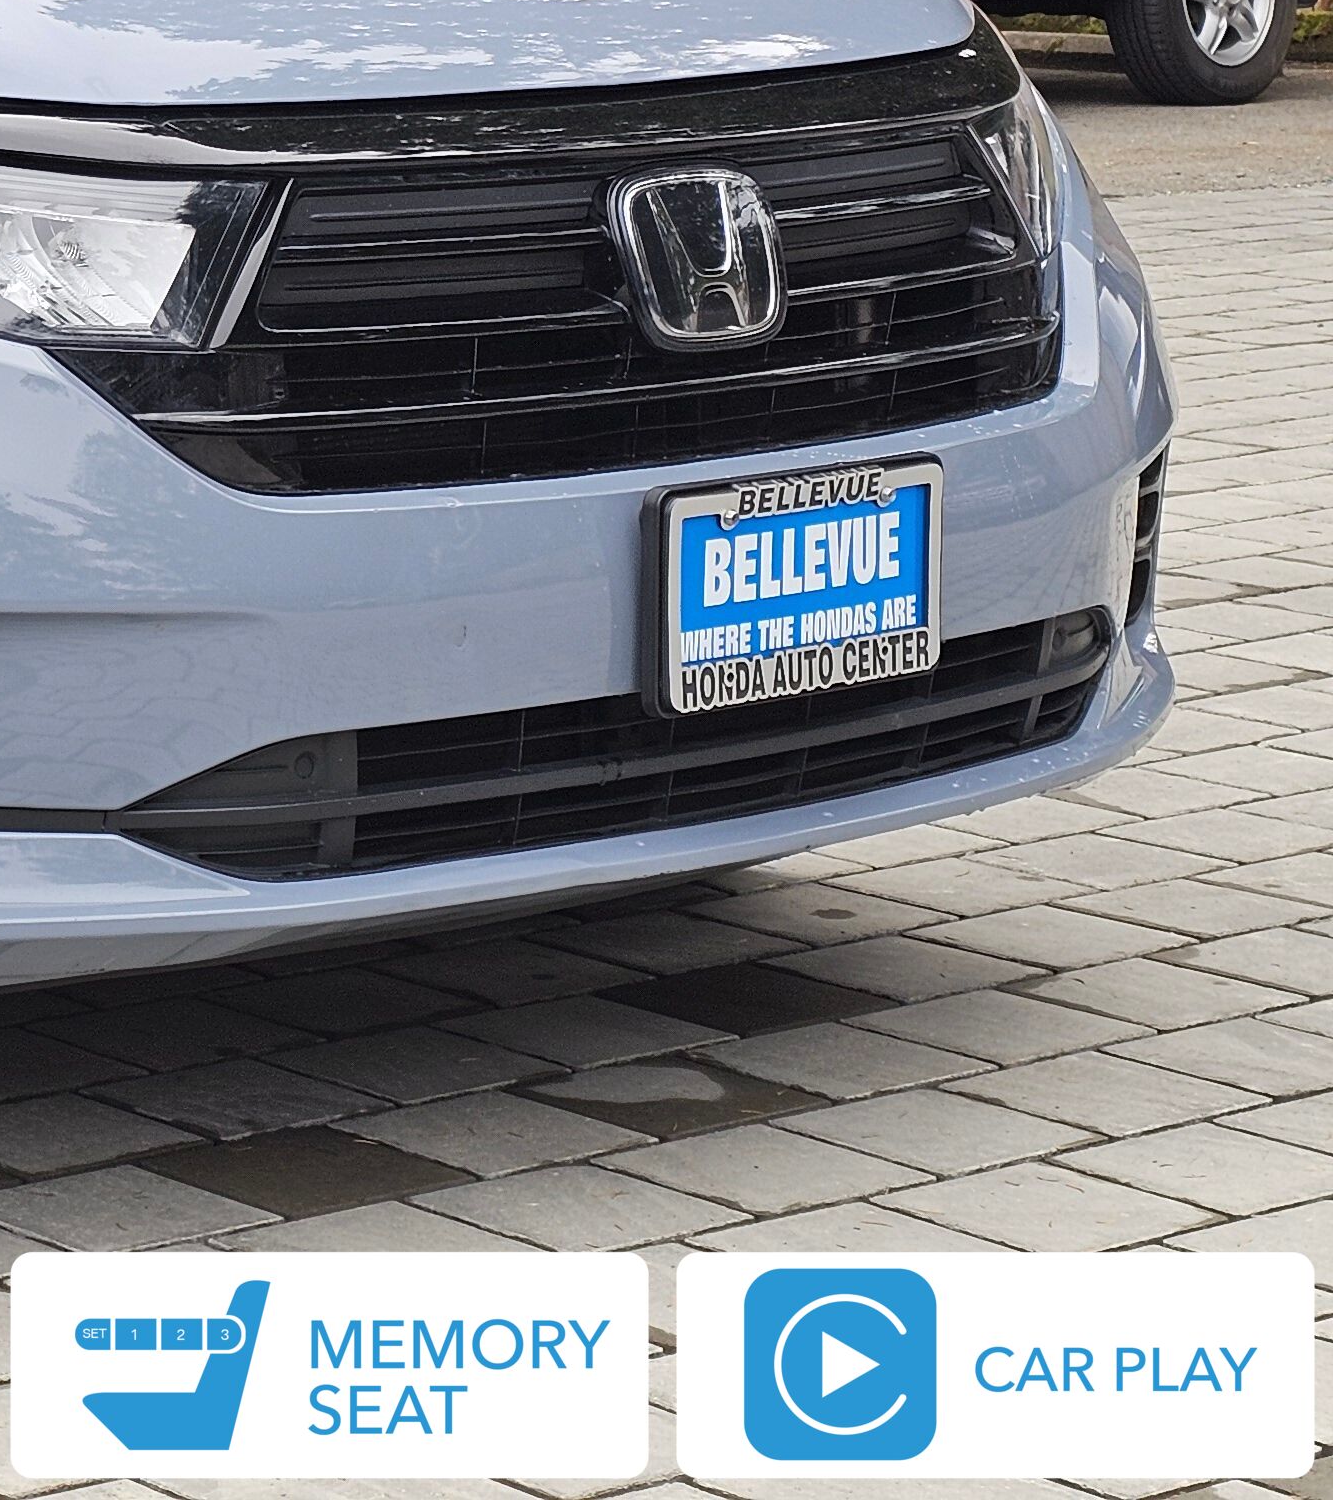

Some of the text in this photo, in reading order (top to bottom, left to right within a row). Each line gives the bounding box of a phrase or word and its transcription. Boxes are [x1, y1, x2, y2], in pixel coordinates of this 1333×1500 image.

[737, 471, 882, 517] BELLEVUE
[703, 511, 900, 608] BELLEVUE
[680, 594, 917, 663] WHERE THE HONDAS ARE
[681, 630, 930, 711] HONDA AUTO CENTER
